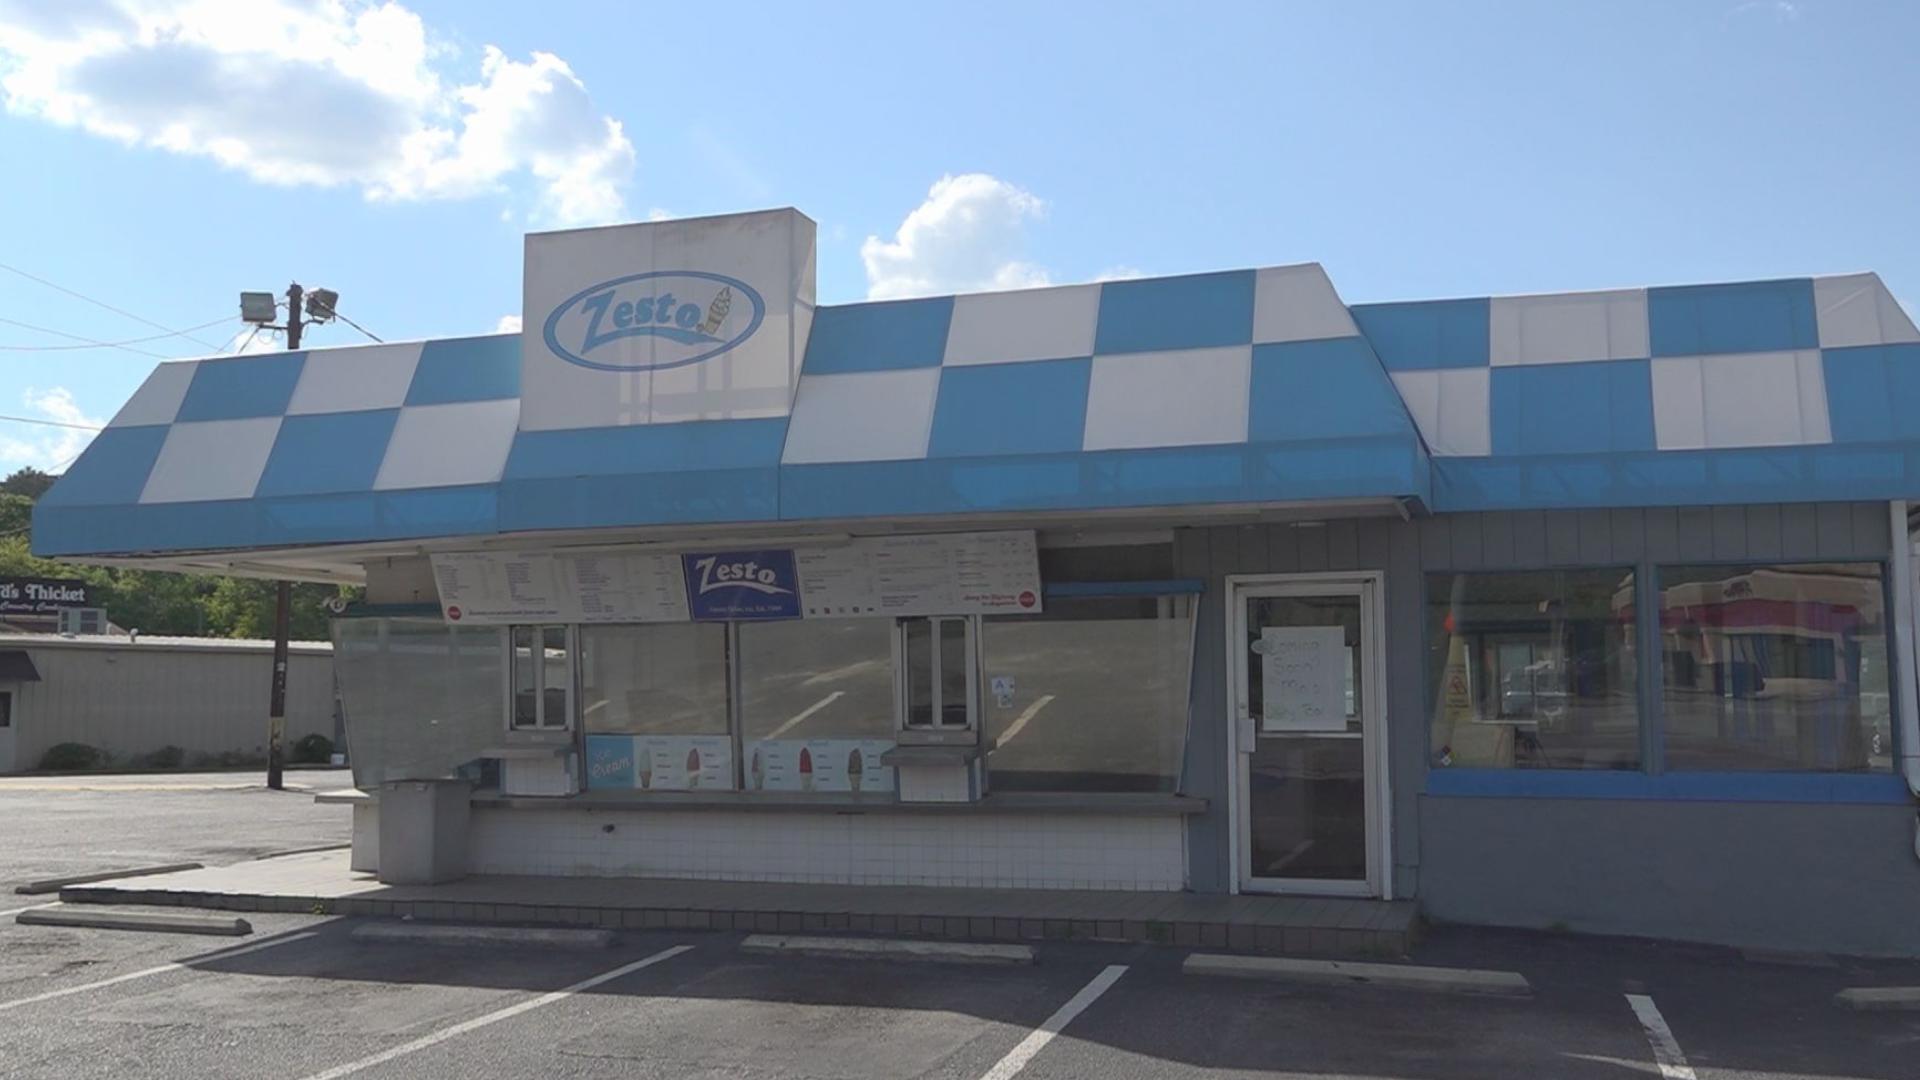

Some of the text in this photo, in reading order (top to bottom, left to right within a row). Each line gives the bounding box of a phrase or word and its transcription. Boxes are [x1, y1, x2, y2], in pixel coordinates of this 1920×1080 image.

[581, 289, 720, 355] Zesto
[25, 583, 86, 602] Thicket
[695, 556, 784, 594] Zesto
